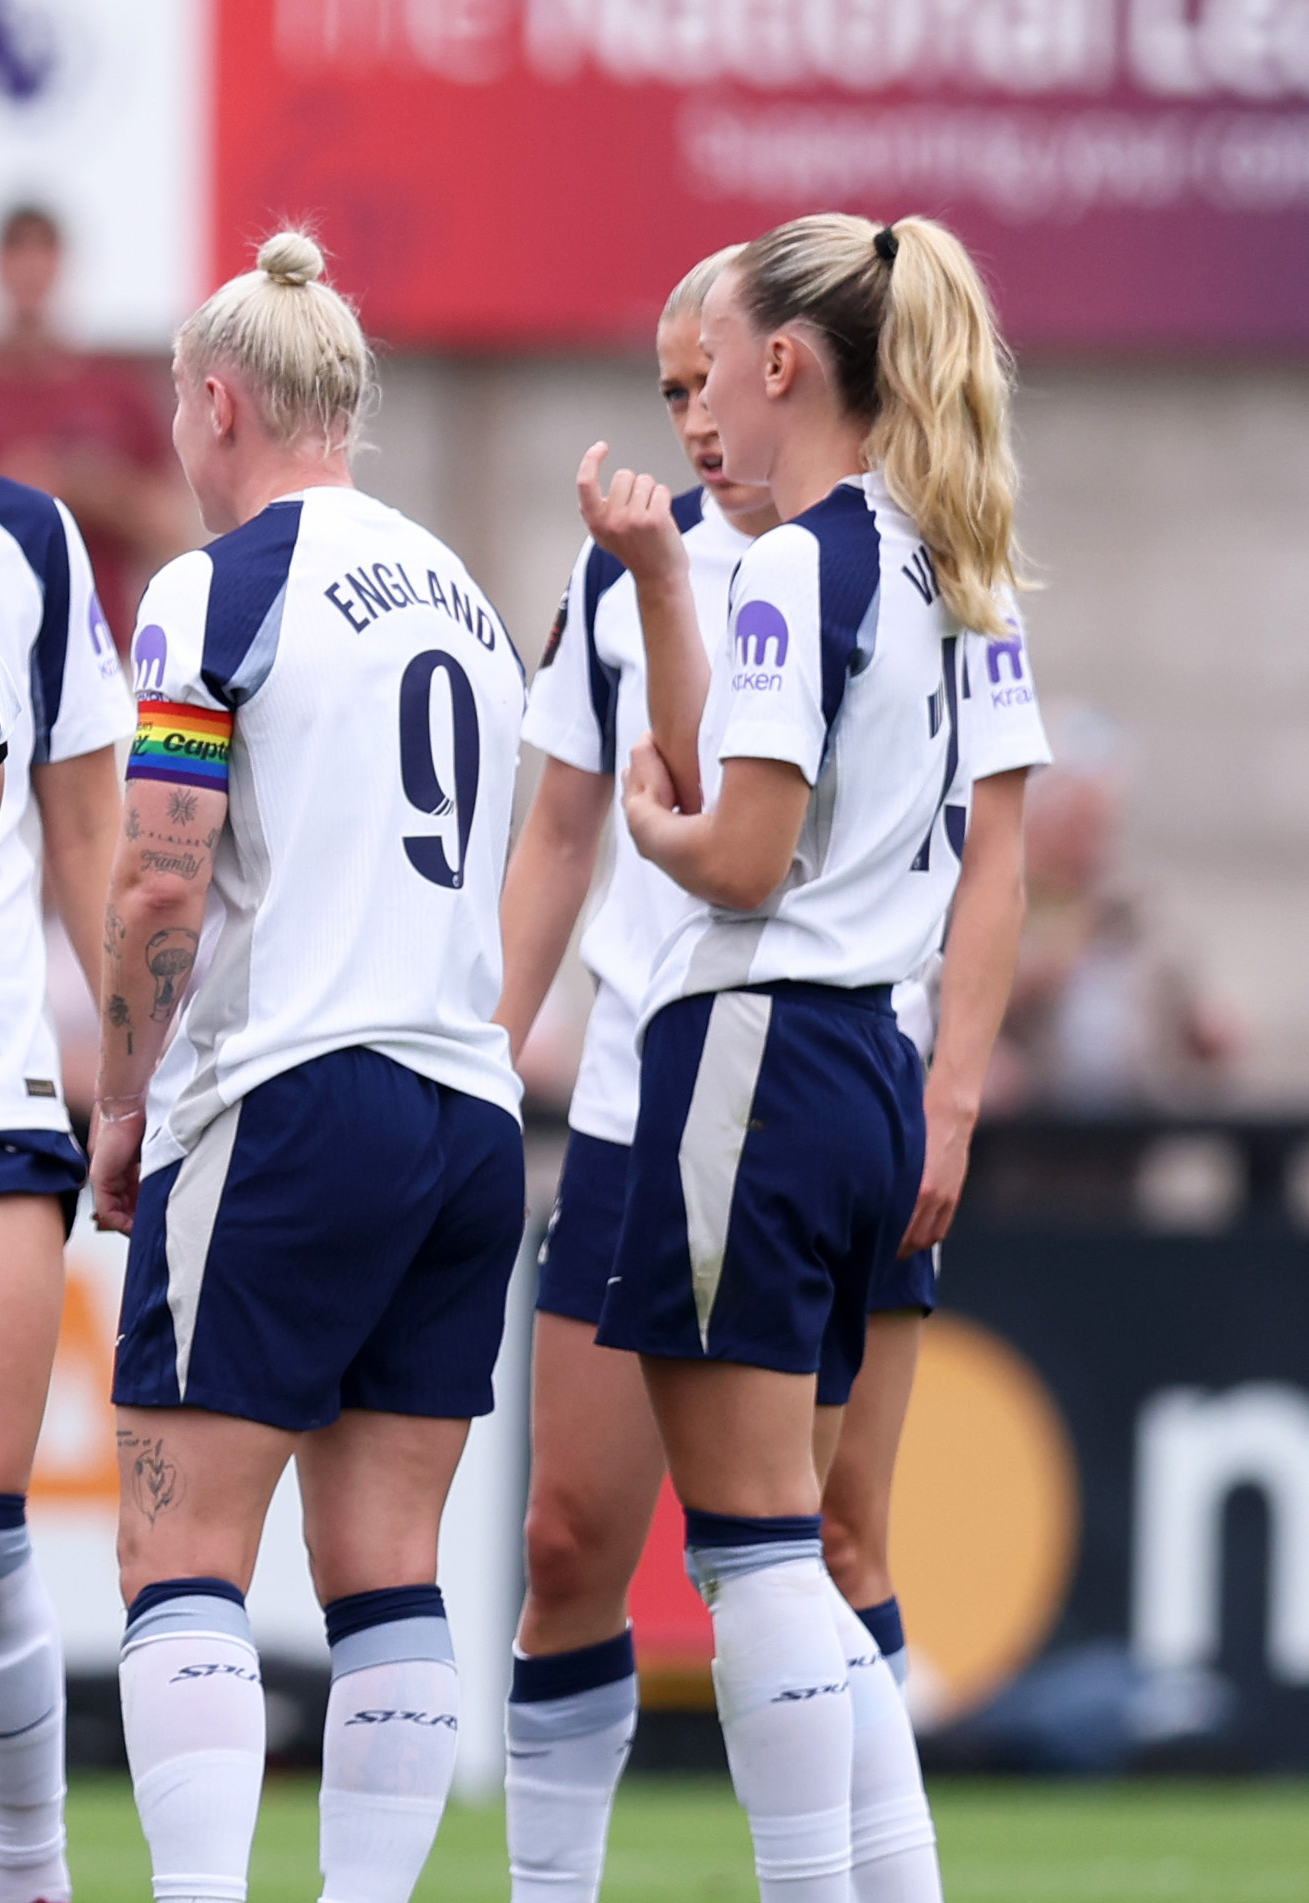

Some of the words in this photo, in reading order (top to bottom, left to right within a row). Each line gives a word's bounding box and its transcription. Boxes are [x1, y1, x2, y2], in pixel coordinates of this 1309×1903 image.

[323, 563, 495, 652] ENGLAND
[162, 732, 231, 761] Capt
[399, 649, 481, 890] 9
[169, 1663, 262, 1684] SPU
[343, 1709, 458, 1732] SPUR
